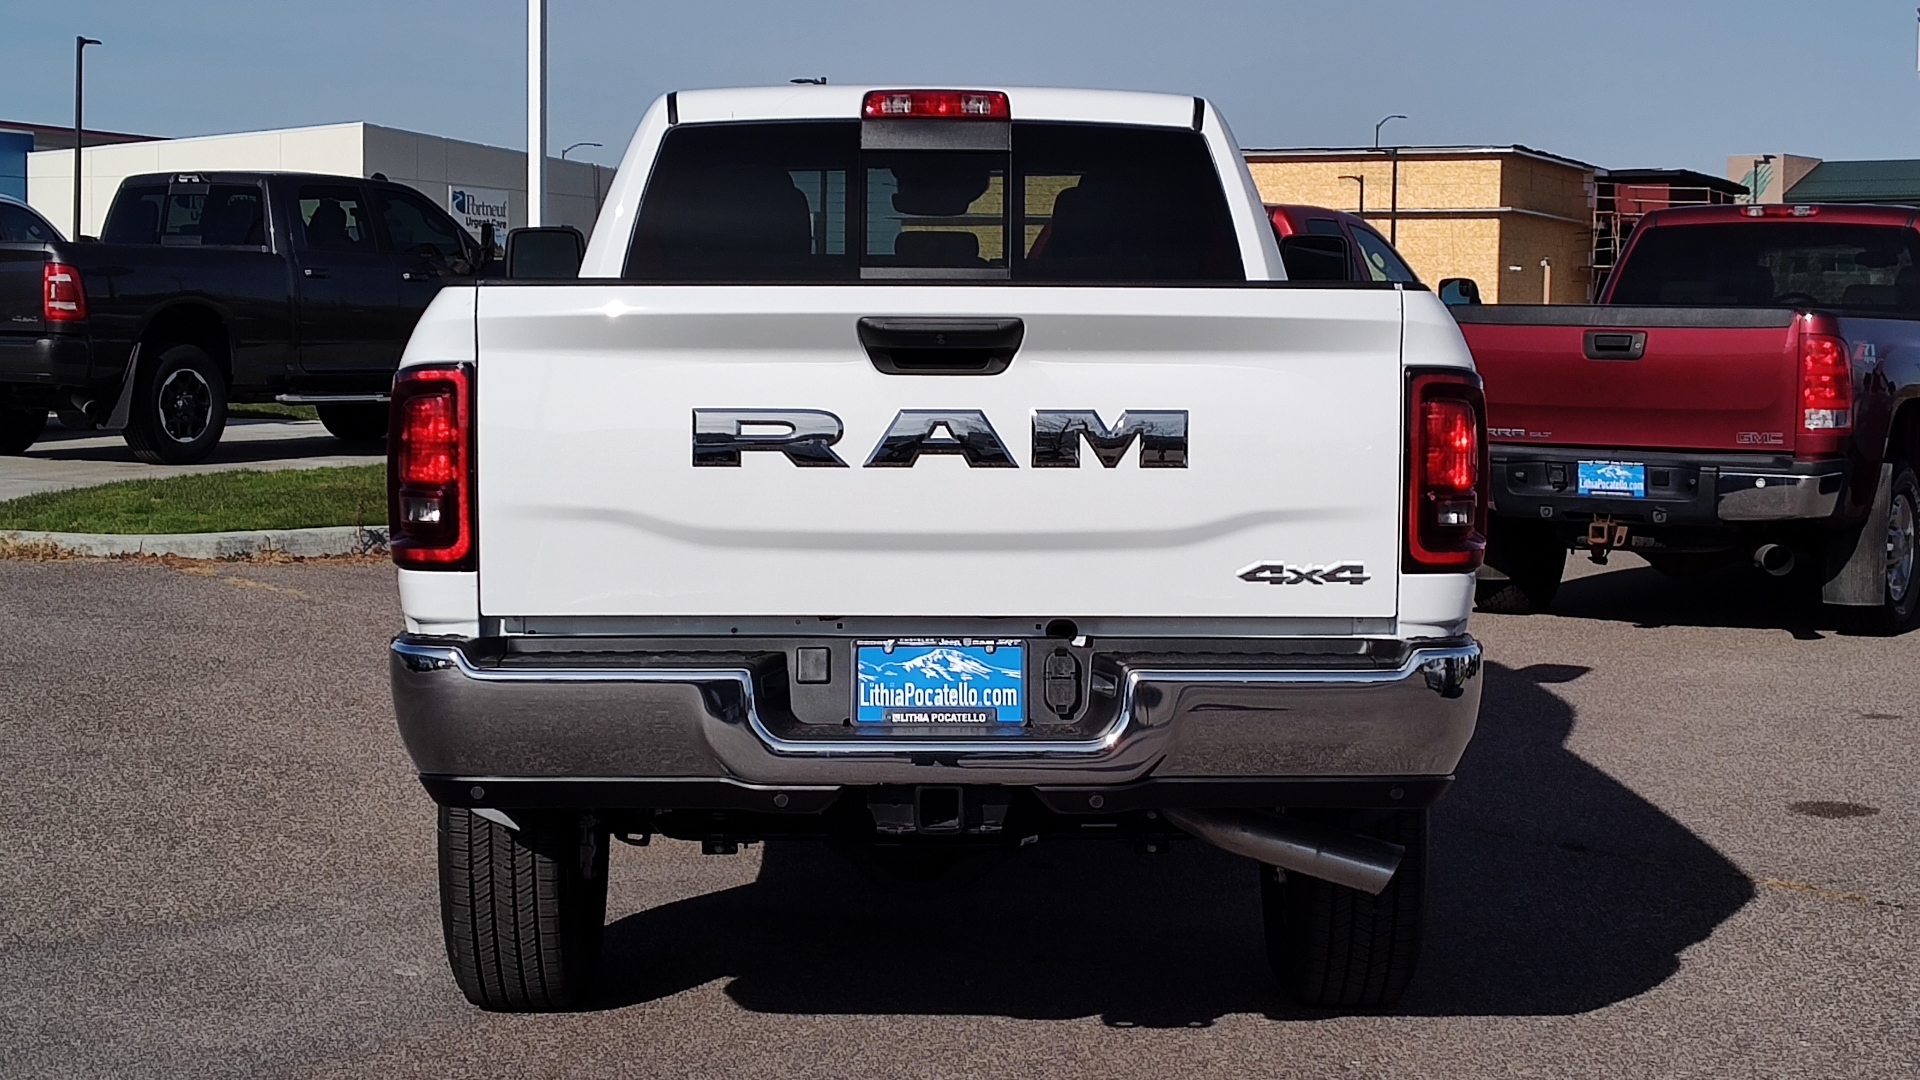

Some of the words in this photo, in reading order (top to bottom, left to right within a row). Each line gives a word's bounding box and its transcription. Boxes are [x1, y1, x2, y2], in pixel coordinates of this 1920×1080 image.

[467, 194, 507, 217] Portneuf
[691, 407, 1189, 469] RAM
[1487, 428, 1525, 437] RRA
[1736, 431, 1784, 444] GMC
[1235, 560, 1372, 586] 4x4
[860, 682, 1017, 707] LithiaPocatello.com
[901, 713, 929, 723] LITHIA
[931, 713, 986, 723] POCATELLO
